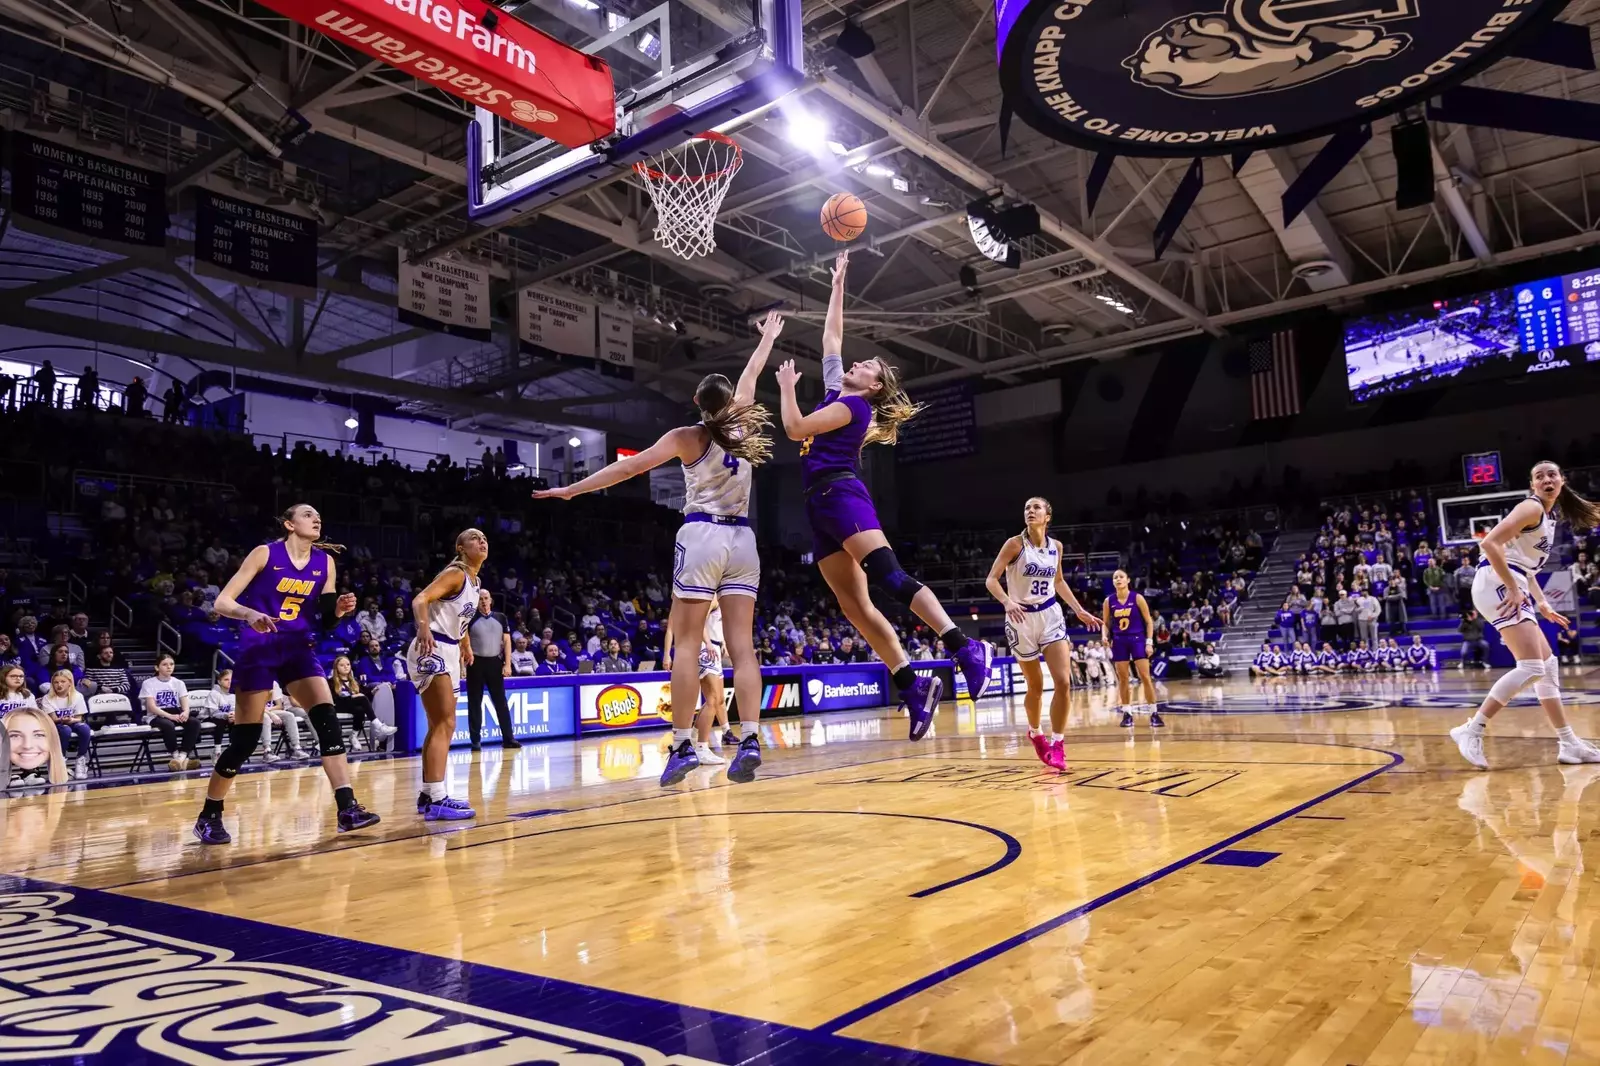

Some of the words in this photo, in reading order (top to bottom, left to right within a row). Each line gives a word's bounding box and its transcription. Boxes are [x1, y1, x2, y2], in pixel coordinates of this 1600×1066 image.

[1033, 25, 1066, 93] KNAPP
[1355, 10, 1523, 108] BULLDOGS
[1044, 91, 1088, 122] THE
[1083, 118, 1120, 136] TO
[1118, 123, 1277, 143] WELCOME
[31, 142, 84, 167] WOMEN'S
[87, 159, 150, 186] BASKETBALL
[62, 169, 137, 197] APPEARANCES
[210, 197, 253, 217] WOMEN'S
[254, 210, 304, 231] BASKETBALL
[234, 219, 295, 242] APPEARANCES
[434, 274, 469, 290] CHAMPIONS
[441, 264, 480, 281] BASKETBALL
[1571, 273, 1600, 289] 8:25
[526, 290, 554, 304] WOMEN'S
[555, 299, 587, 314] BASKETBALL
[1541, 287, 1553, 300] 6
[549, 308, 578, 323] CHAMPIONS
[1526, 359, 1571, 373] ACURA
[722, 453, 740, 476] 4
[1472, 465, 1496, 483] 22
[275, 577, 316, 596] UNI
[1031, 580, 1048, 596] 32
[279, 596, 305, 621] 5
[529, 724, 550, 733] HAIL
